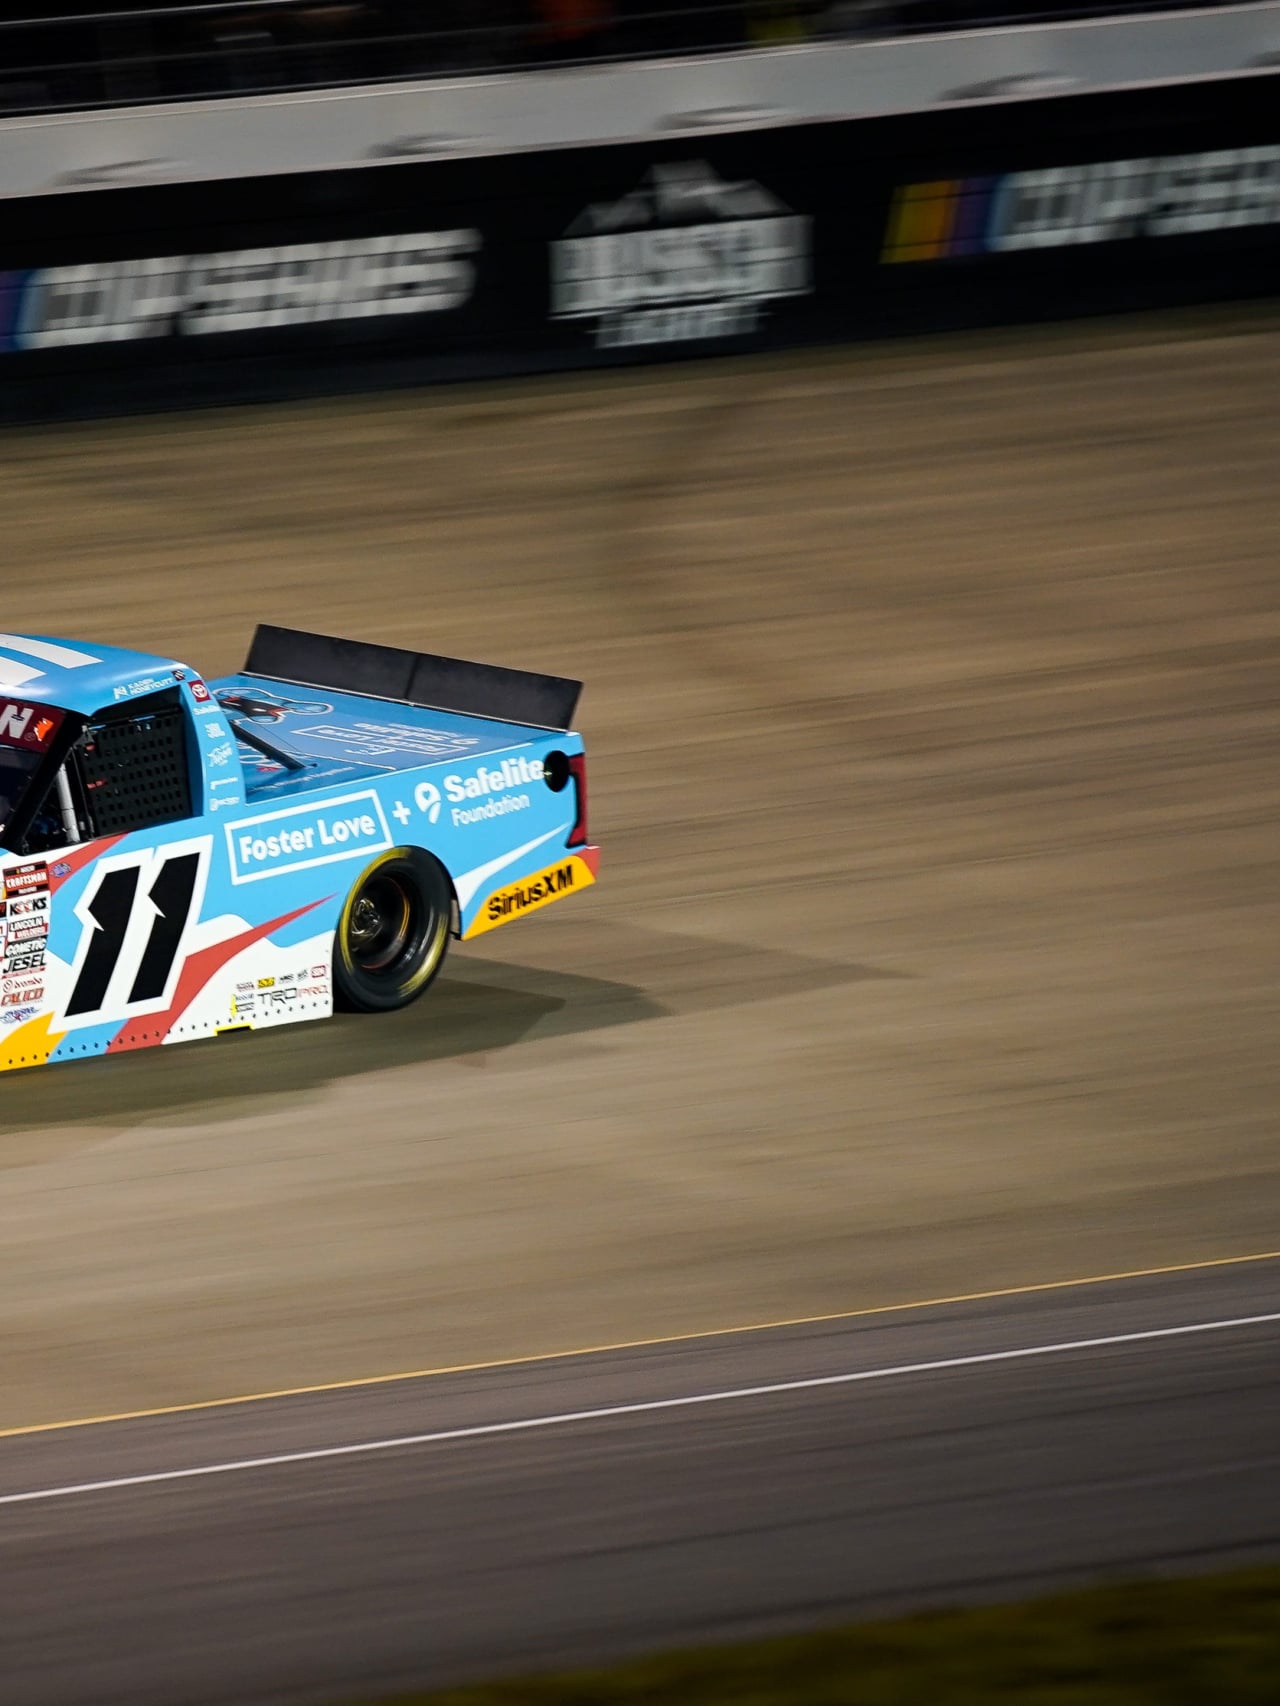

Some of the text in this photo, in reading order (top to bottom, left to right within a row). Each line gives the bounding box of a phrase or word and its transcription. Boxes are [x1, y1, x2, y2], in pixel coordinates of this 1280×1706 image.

[239, 823, 315, 864] Foster
[319, 811, 378, 844] Love
[443, 756, 545, 803] Safelite
[451, 793, 531, 827] Foundation
[5, 872, 48, 889] CRAFTSMAN
[488, 864, 574, 921] SiriusXM
[9, 897, 47, 917] KOOKS
[9, 916, 44, 932] LINCOLN
[64, 852, 201, 1018] 11
[2, 953, 47, 974] JESEL
[1, 987, 45, 1006] CALICO
